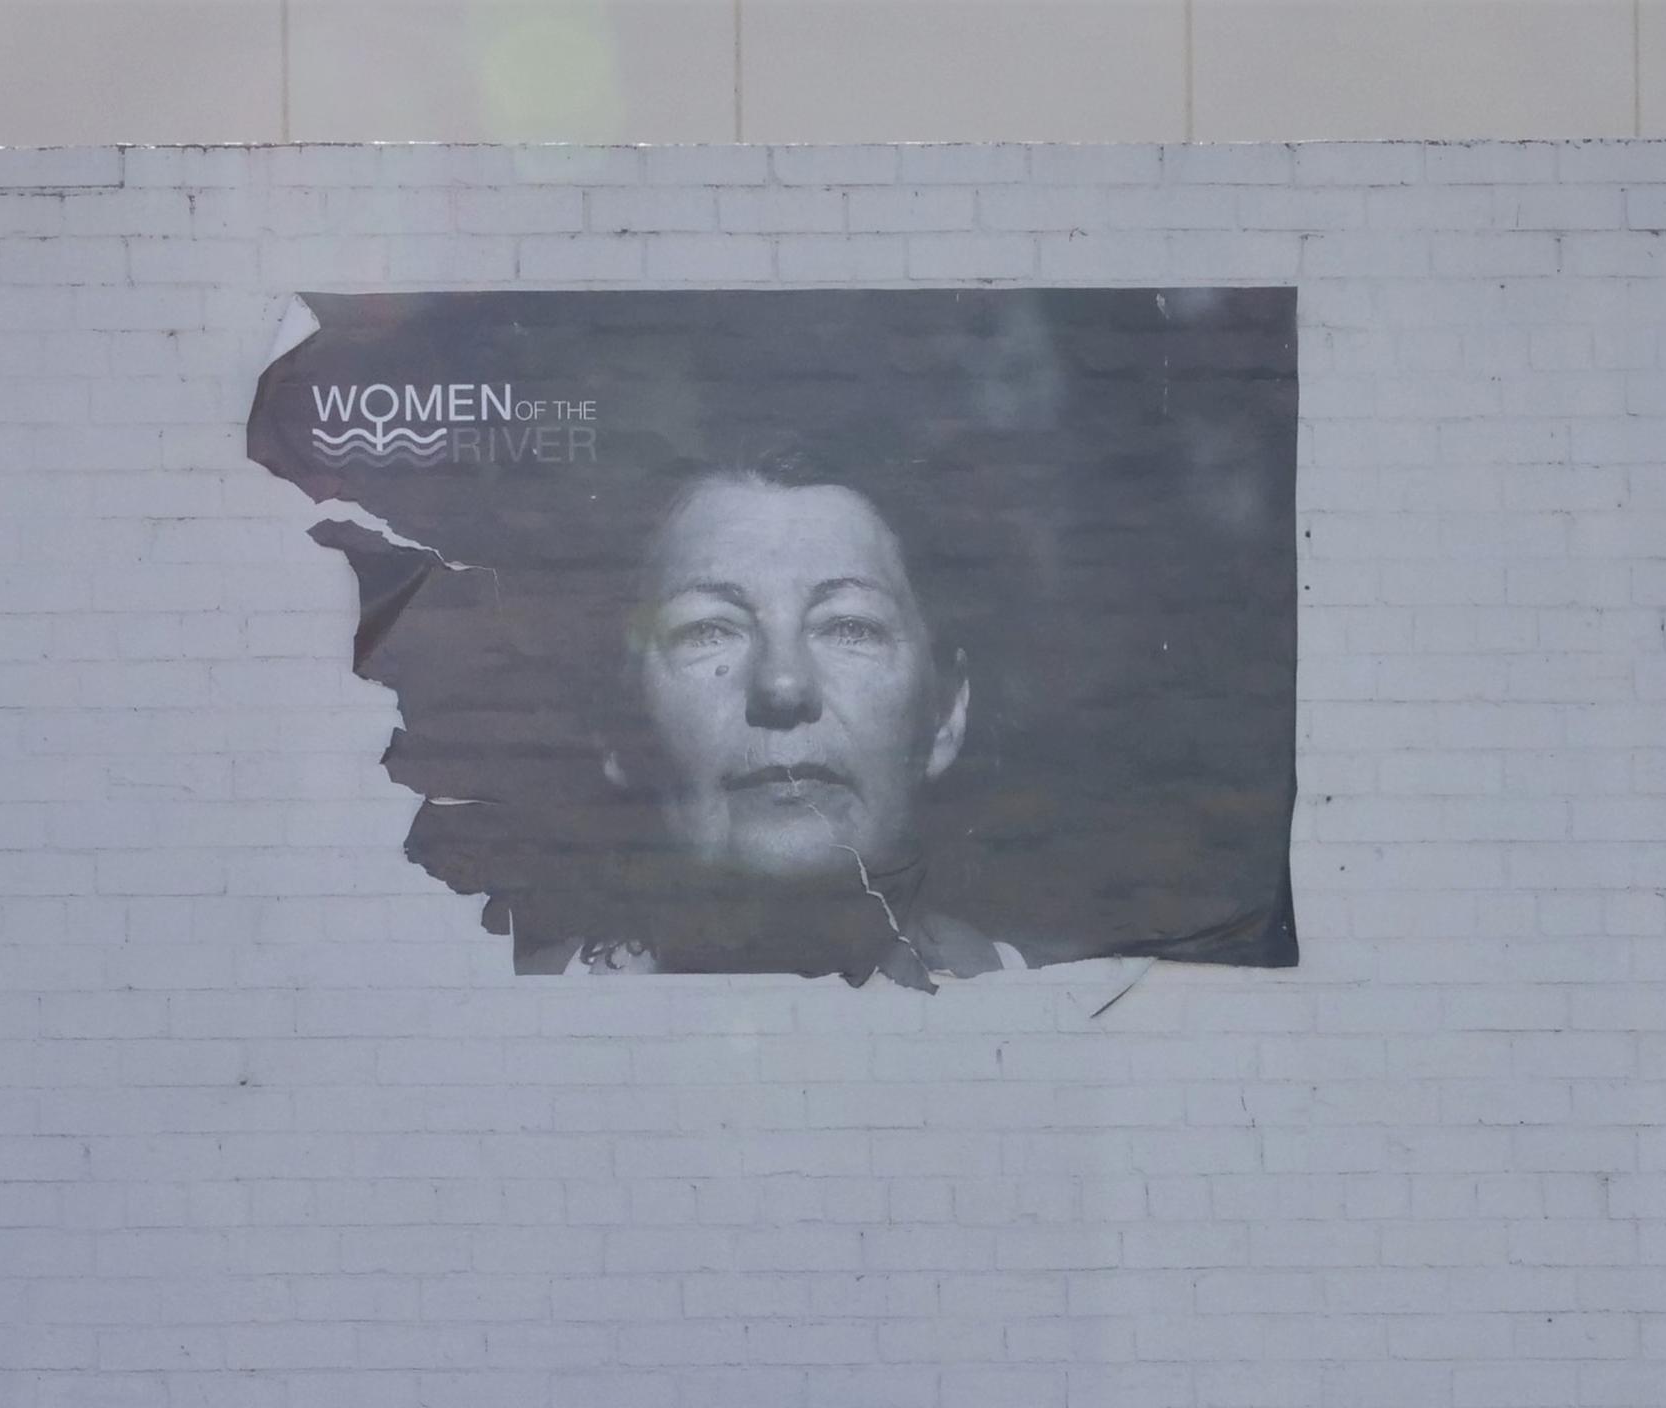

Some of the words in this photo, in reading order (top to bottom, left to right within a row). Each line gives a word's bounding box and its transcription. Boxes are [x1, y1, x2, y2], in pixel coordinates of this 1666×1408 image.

[312, 383, 511, 422] WOMEN
[515, 400, 546, 421] OF
[552, 400, 597, 421] THE
[451, 426, 597, 463] RIVER
